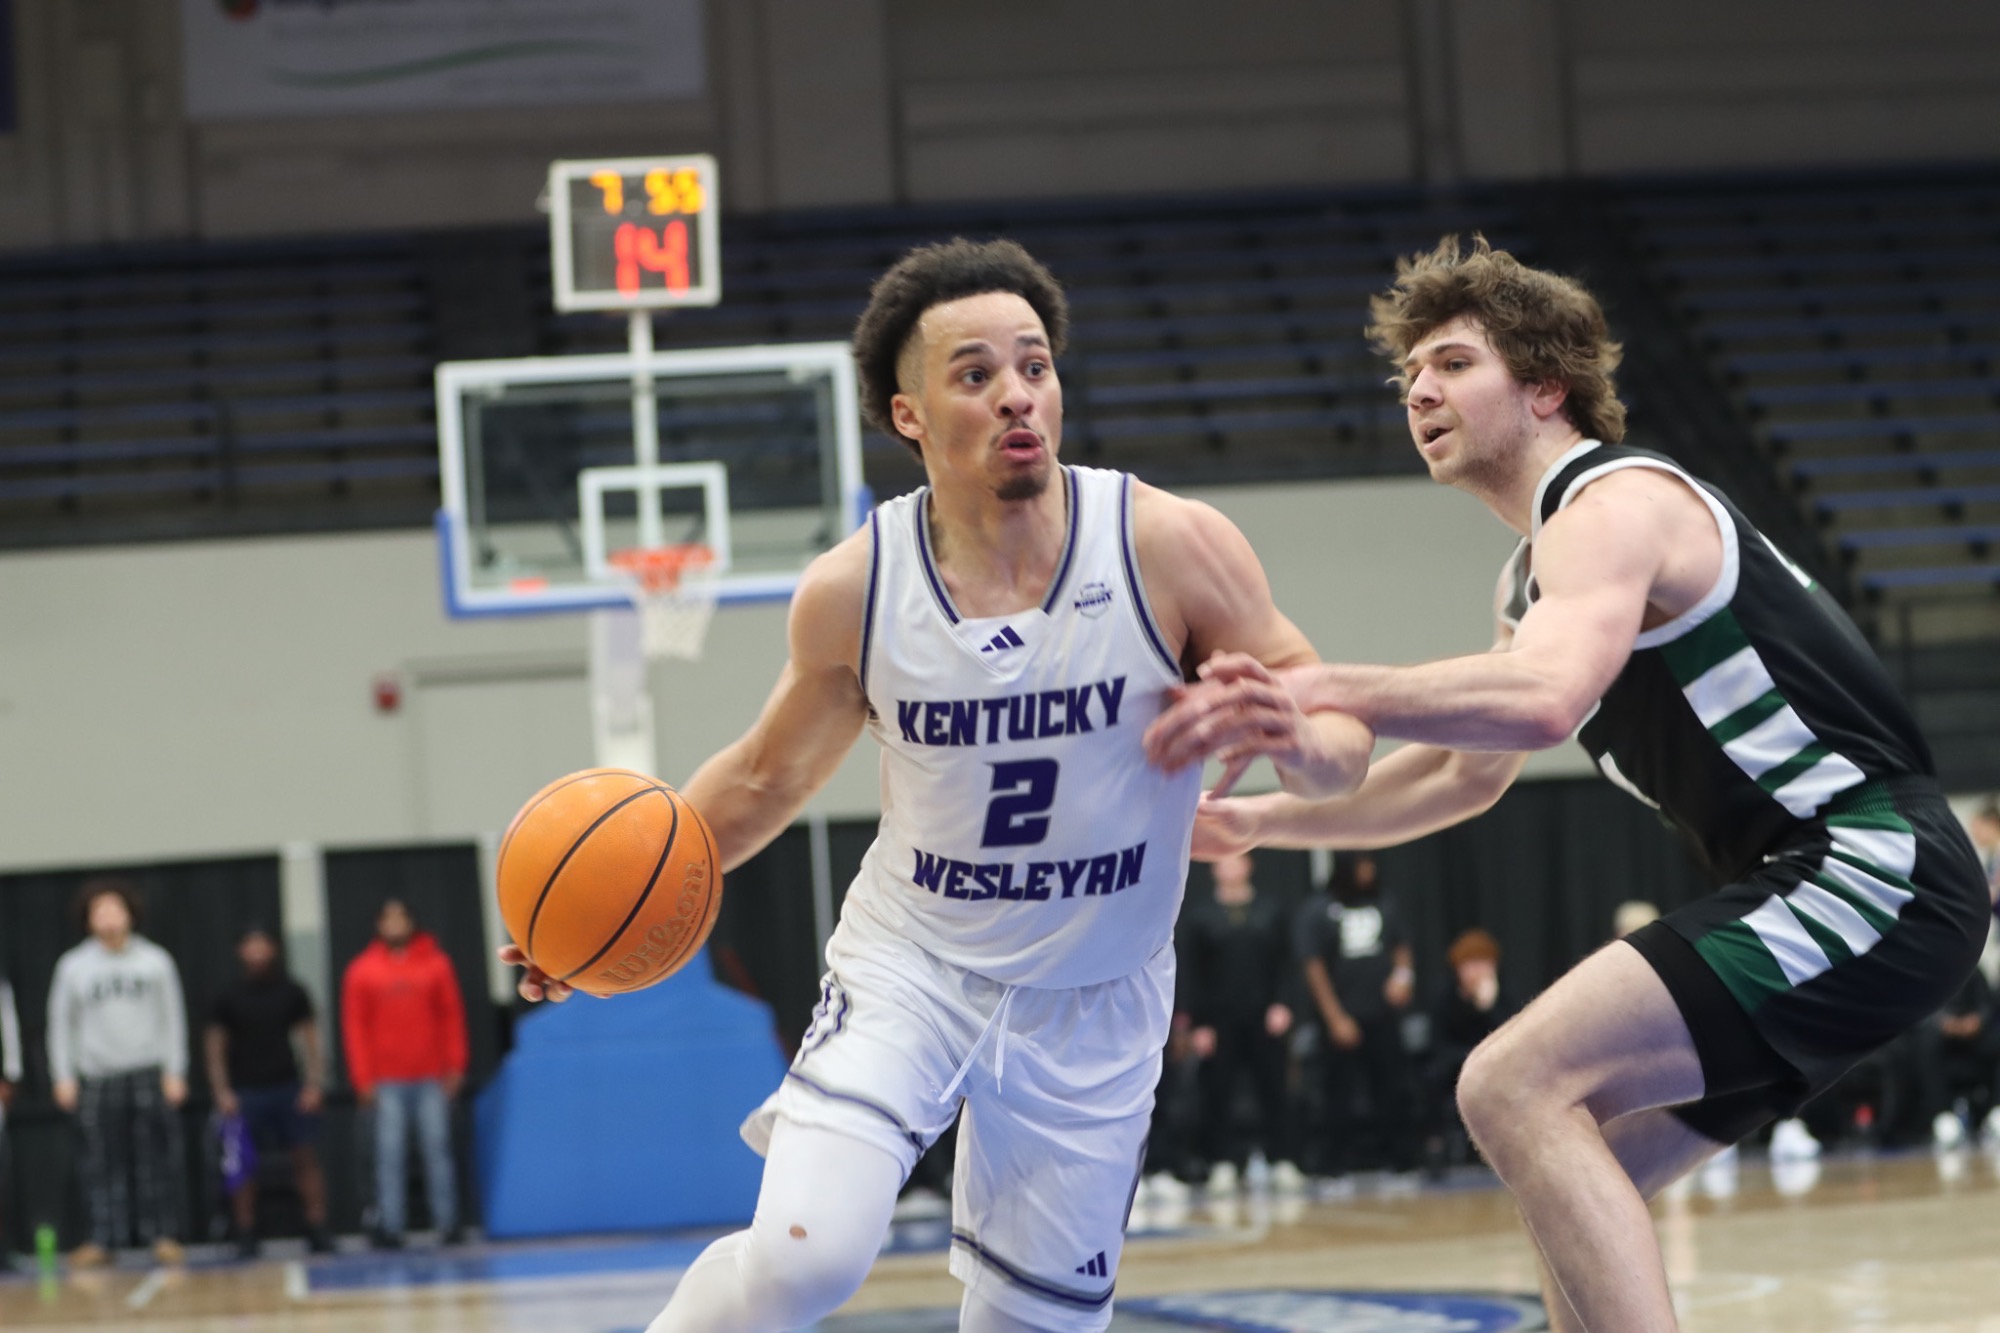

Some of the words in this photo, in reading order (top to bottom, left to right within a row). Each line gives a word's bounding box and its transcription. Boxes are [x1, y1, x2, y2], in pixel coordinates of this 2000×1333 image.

[614, 220, 690, 299] 14
[897, 675, 1127, 746] KENTUCKY
[979, 757, 1060, 848] 2
[912, 840, 1148, 901] WESLEYAN
